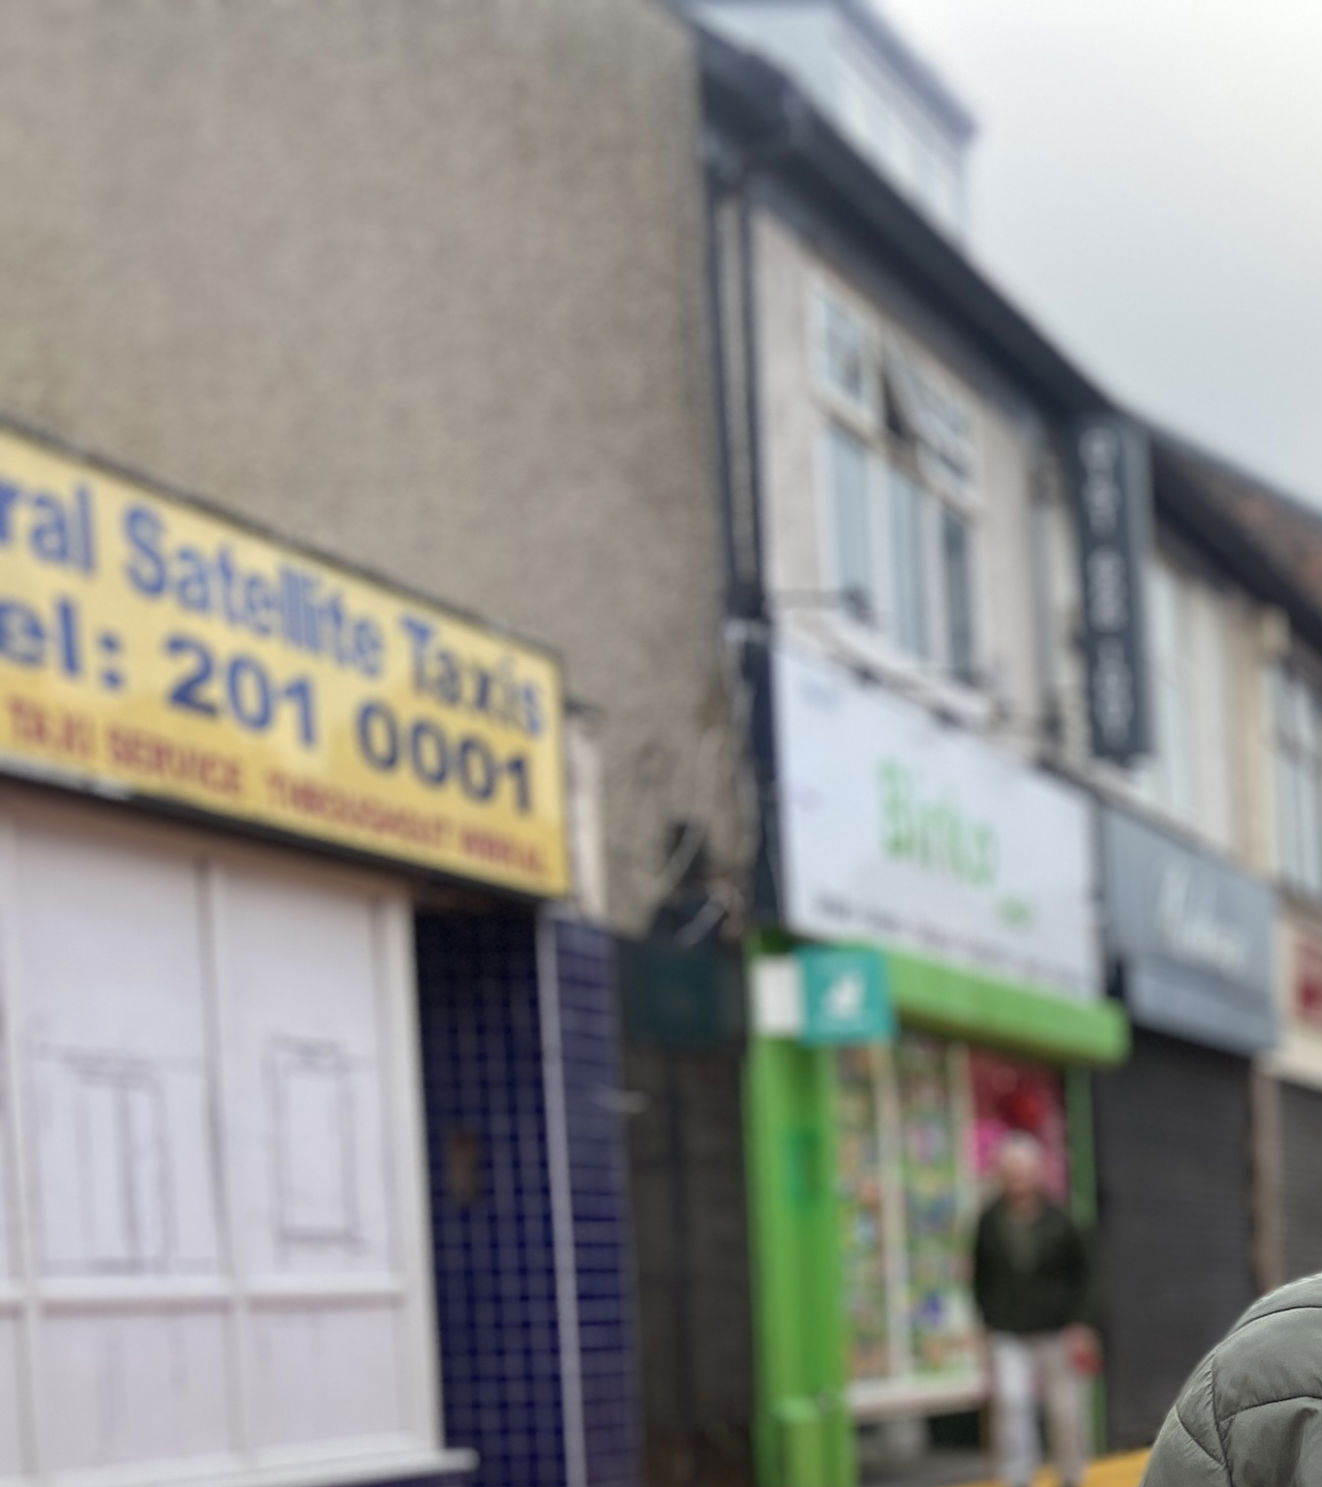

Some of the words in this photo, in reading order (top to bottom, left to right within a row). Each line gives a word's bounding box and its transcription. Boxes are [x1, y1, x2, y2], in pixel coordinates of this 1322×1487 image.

[123, 506, 382, 675] Satellite
[402, 615, 543, 733] Taxis
[167, 635, 313, 745] 201
[357, 701, 531, 812] 0001
